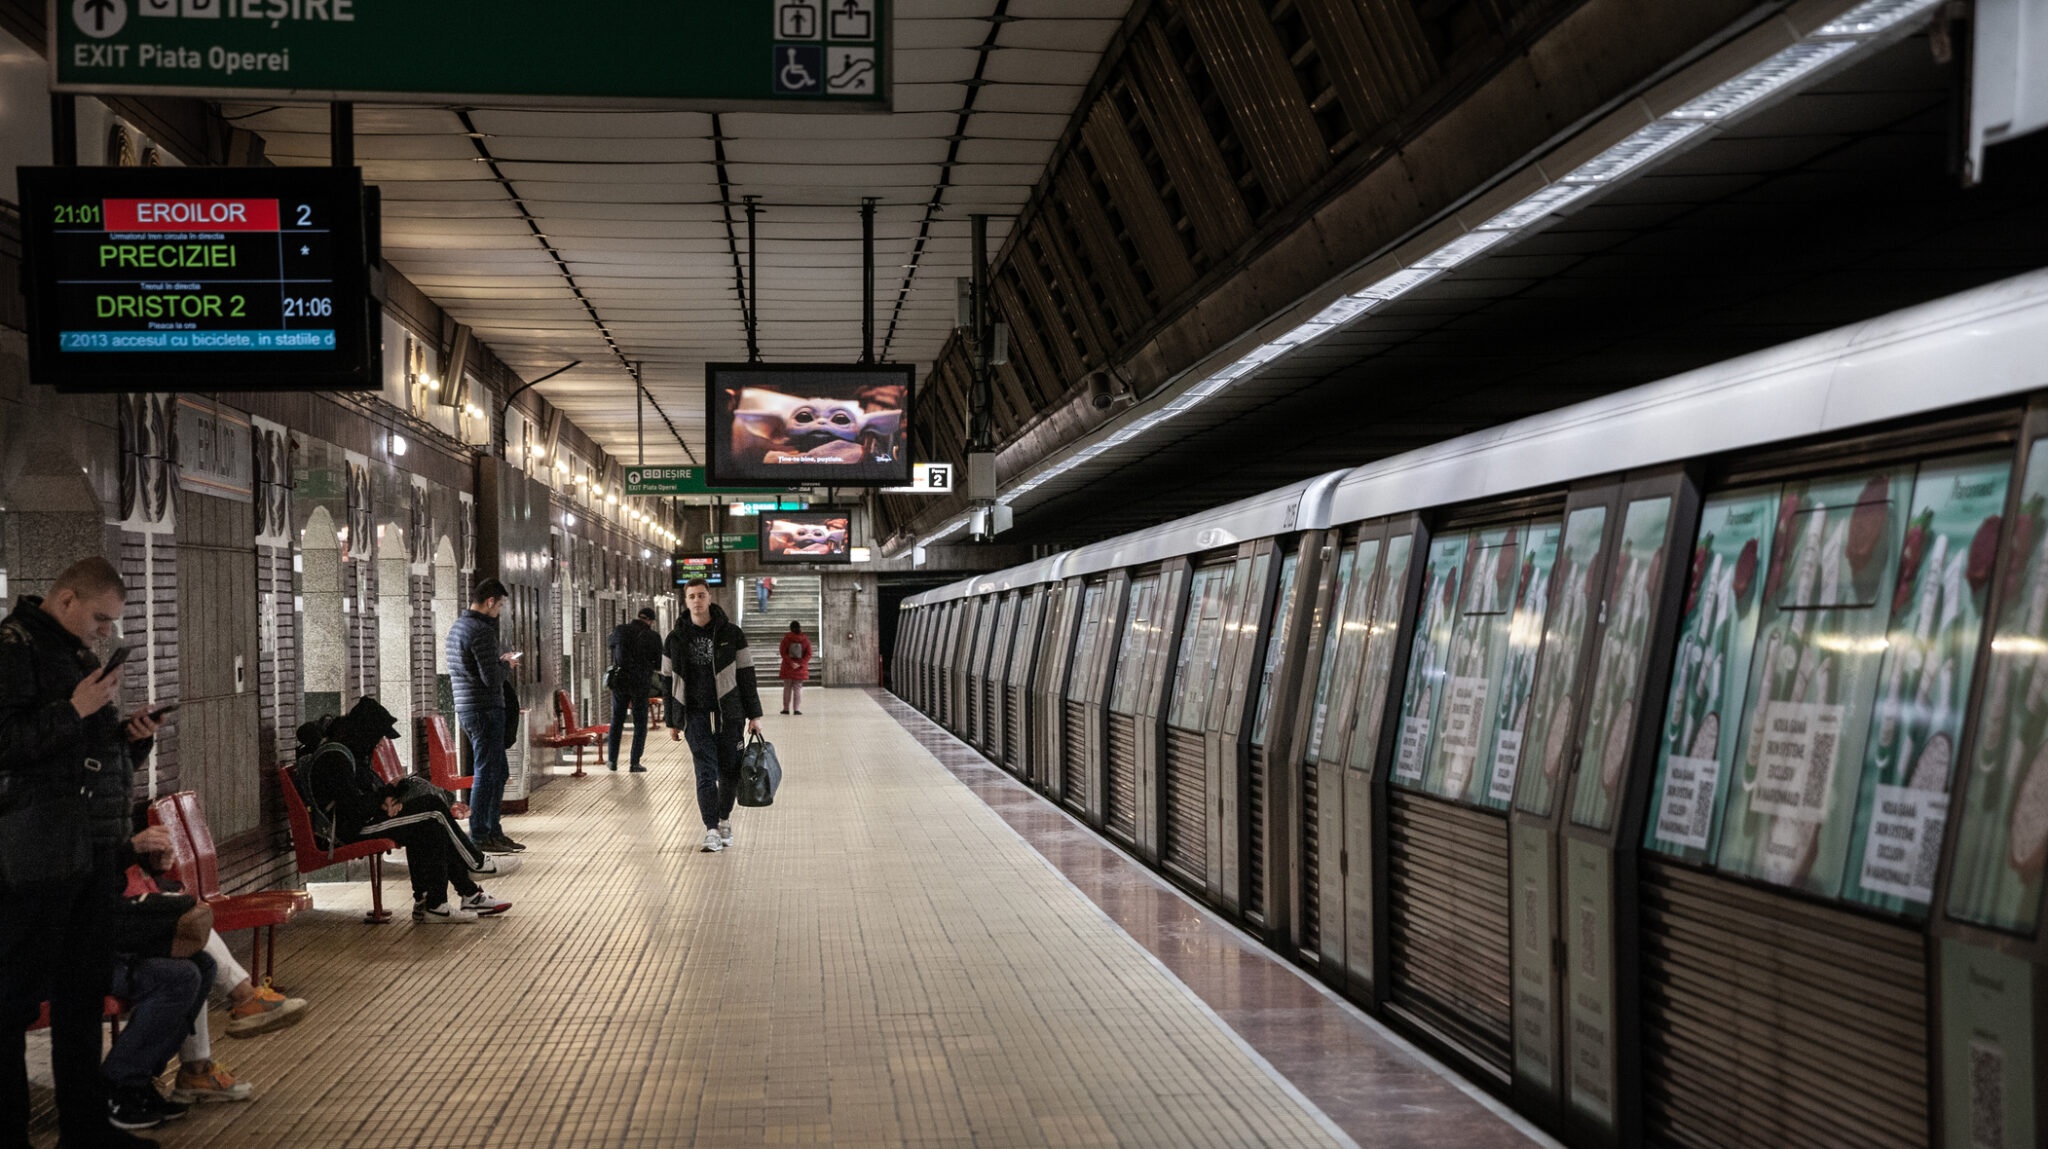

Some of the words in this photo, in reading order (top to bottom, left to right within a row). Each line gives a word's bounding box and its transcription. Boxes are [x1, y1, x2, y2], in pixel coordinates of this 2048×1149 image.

[74, 44, 129, 67] EXIT
[139, 45, 202, 68] Piata
[208, 46, 290, 75] Operei
[54, 205, 100, 223] 21:01
[137, 203, 247, 223] EROILOR
[296, 205, 312, 225] 2
[99, 245, 237, 268] PRECIZIEI
[96, 295, 223, 318] DRISTOR
[230, 295, 246, 317] 2
[283, 298, 332, 317] 21:06
[112, 334, 167, 347] accesul
[171, 336, 188, 347] cu
[192, 333, 255, 348] biciclete,
[258, 333, 272, 345] in
[275, 332, 321, 346] statiile
[662, 469, 692, 481] IEȘIRE
[933, 474, 943, 486] 2
